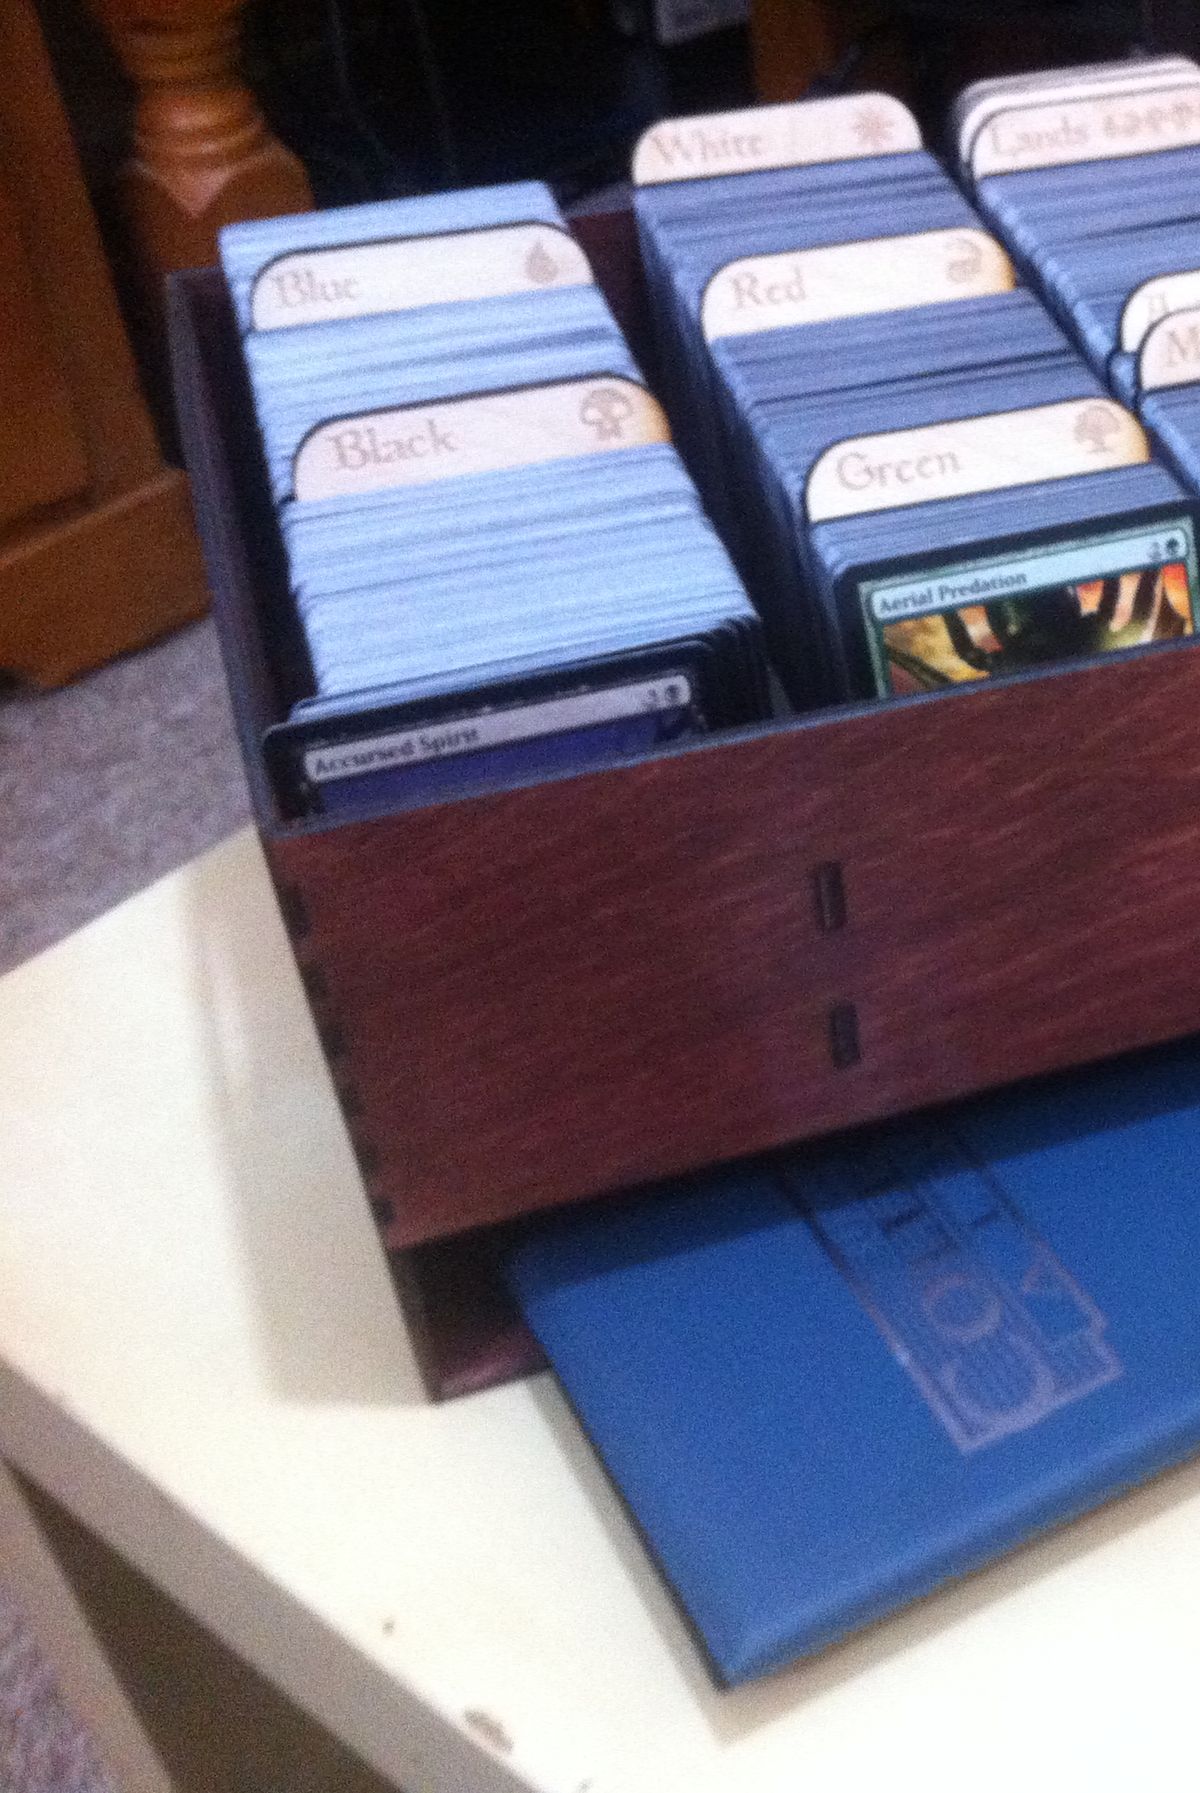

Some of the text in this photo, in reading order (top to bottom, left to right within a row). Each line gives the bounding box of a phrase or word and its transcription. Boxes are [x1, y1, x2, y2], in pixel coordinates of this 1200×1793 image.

[650, 128, 764, 167] White
[989, 112, 1090, 157] Lands
[270, 265, 358, 309] Blue
[731, 268, 806, 312] Red
[329, 418, 458, 471] Black
[836, 448, 962, 492] Green
[879, 572, 1028, 613] Aerial Predation
[315, 724, 479, 777] Accursed Spirit
